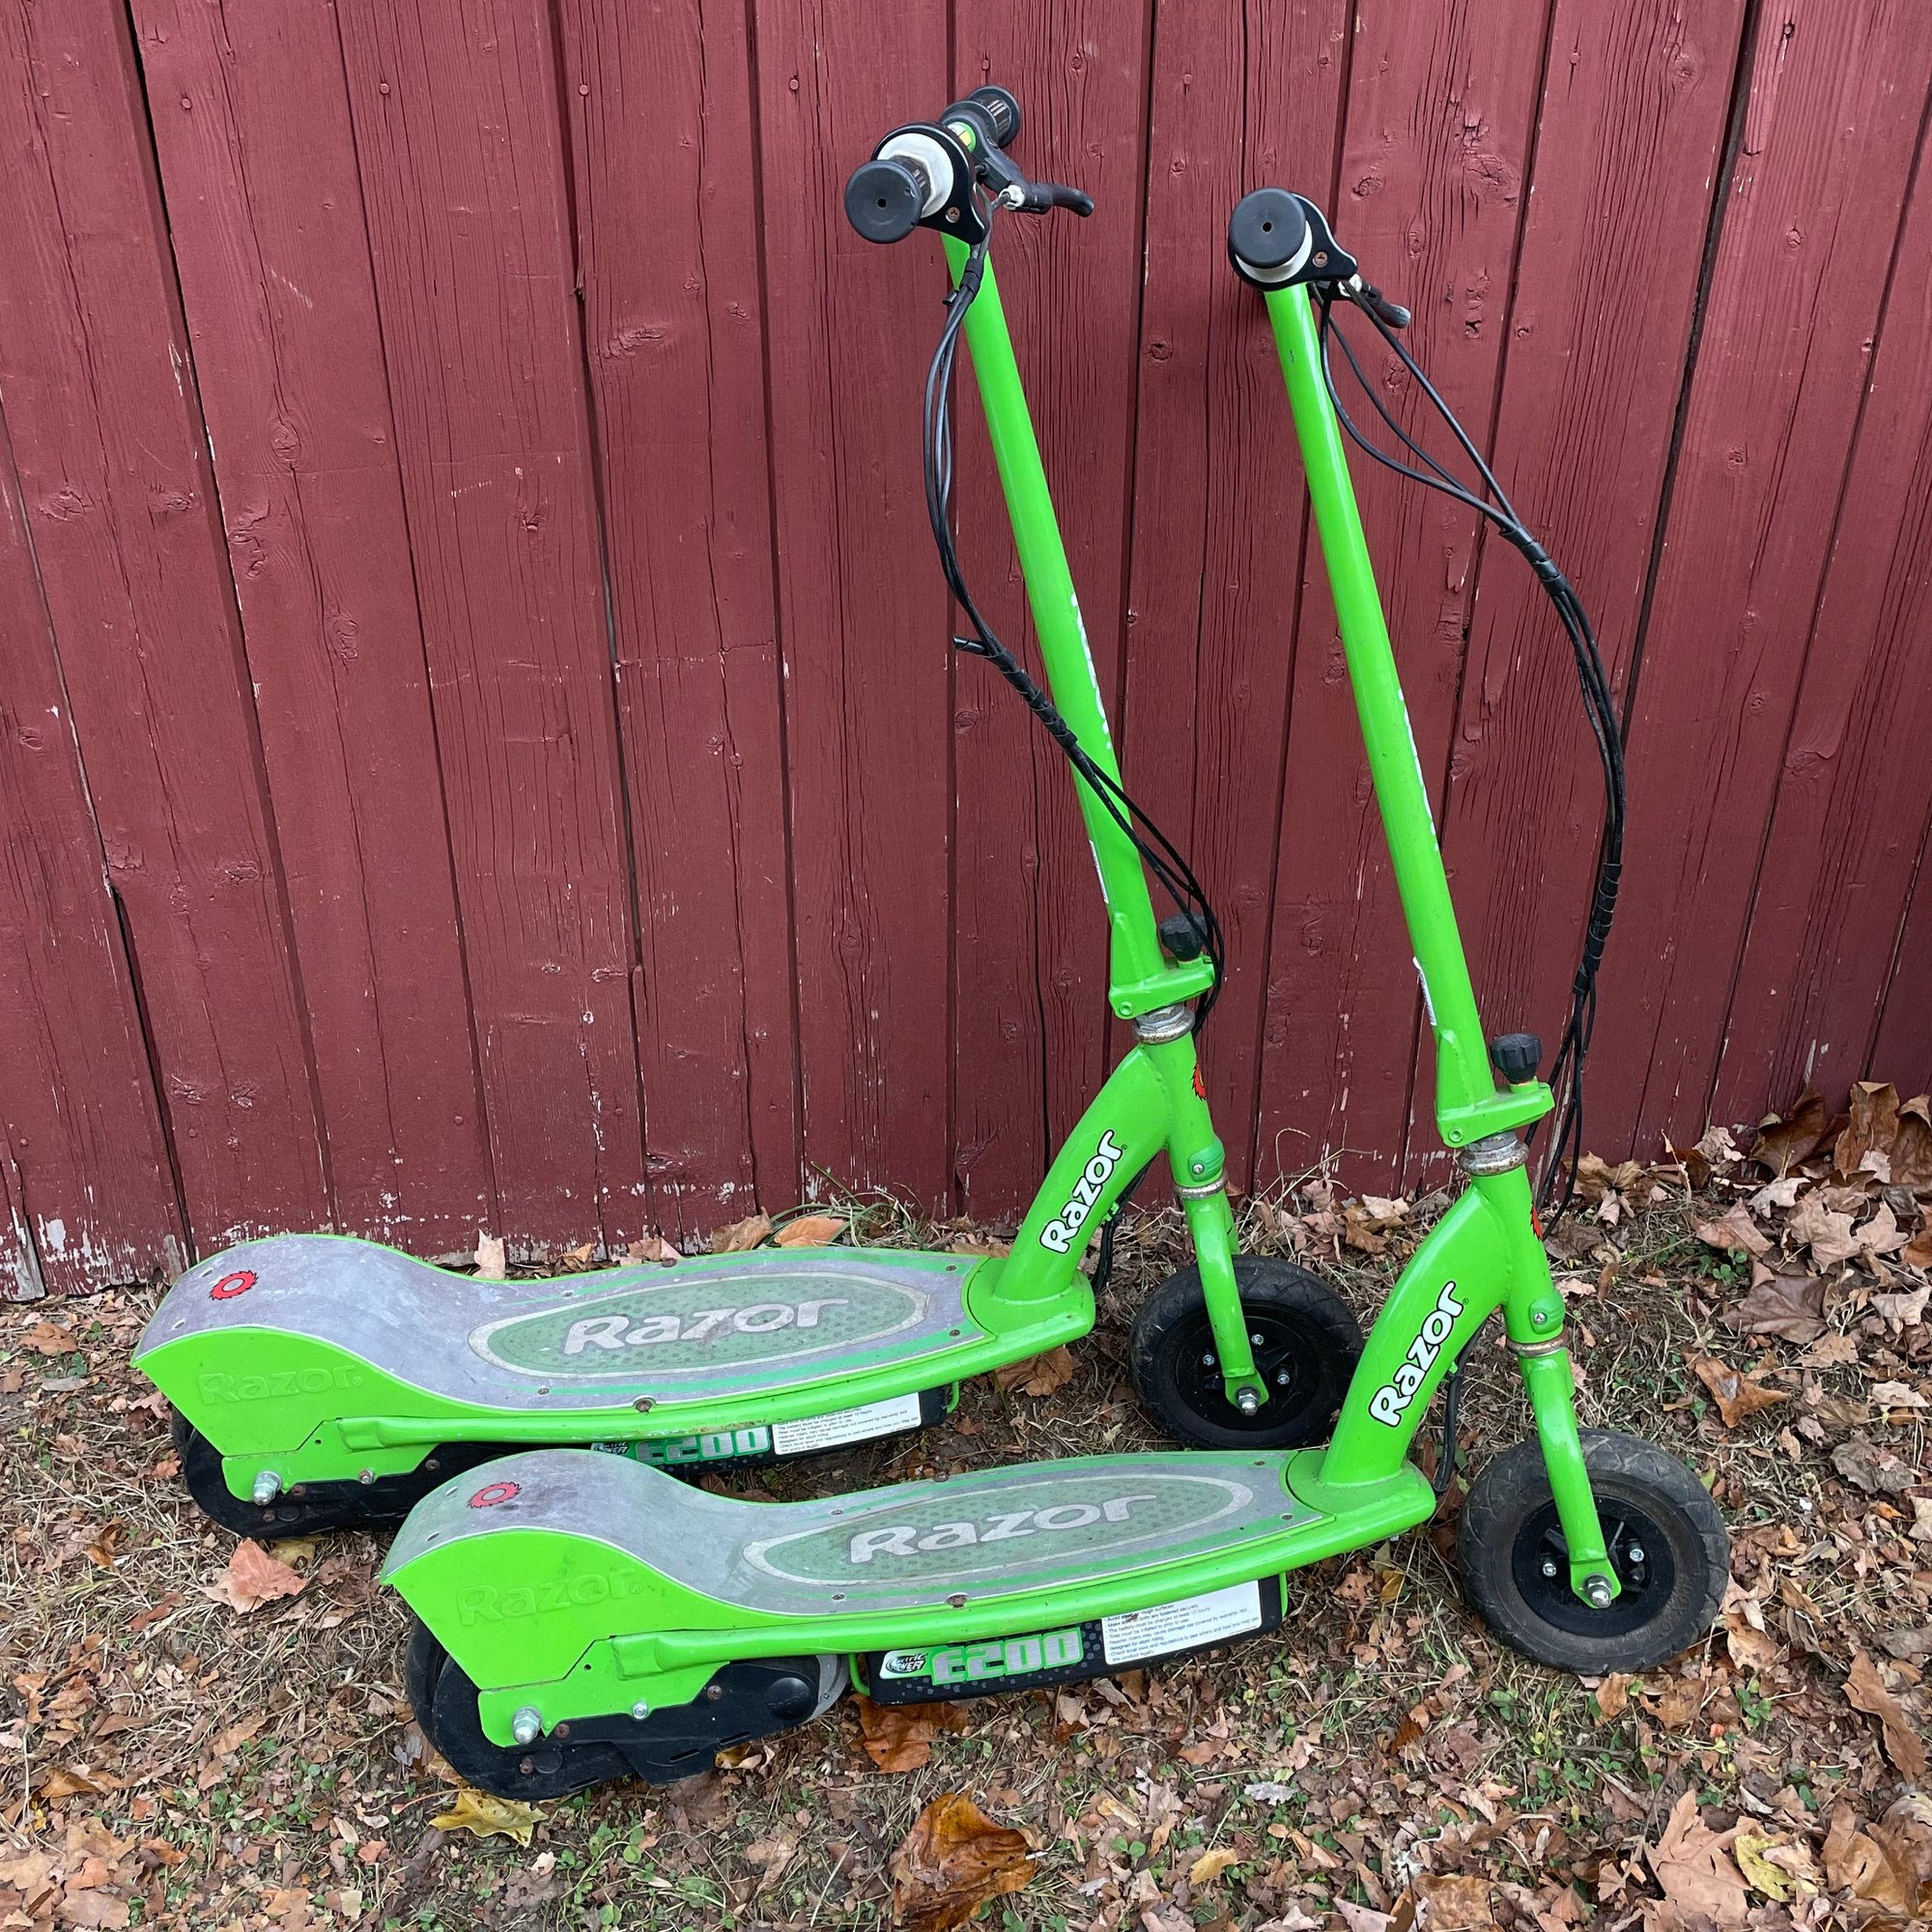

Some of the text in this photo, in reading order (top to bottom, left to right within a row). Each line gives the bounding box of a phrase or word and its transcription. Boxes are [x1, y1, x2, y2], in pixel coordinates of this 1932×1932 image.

[1039, 1128, 1122, 1254] Razor
[564, 1298, 849, 1354] Razor
[1369, 1280, 1464, 1428] Razor
[850, 1494, 1157, 1564] Razor
[932, 1628, 1083, 1686] E200
